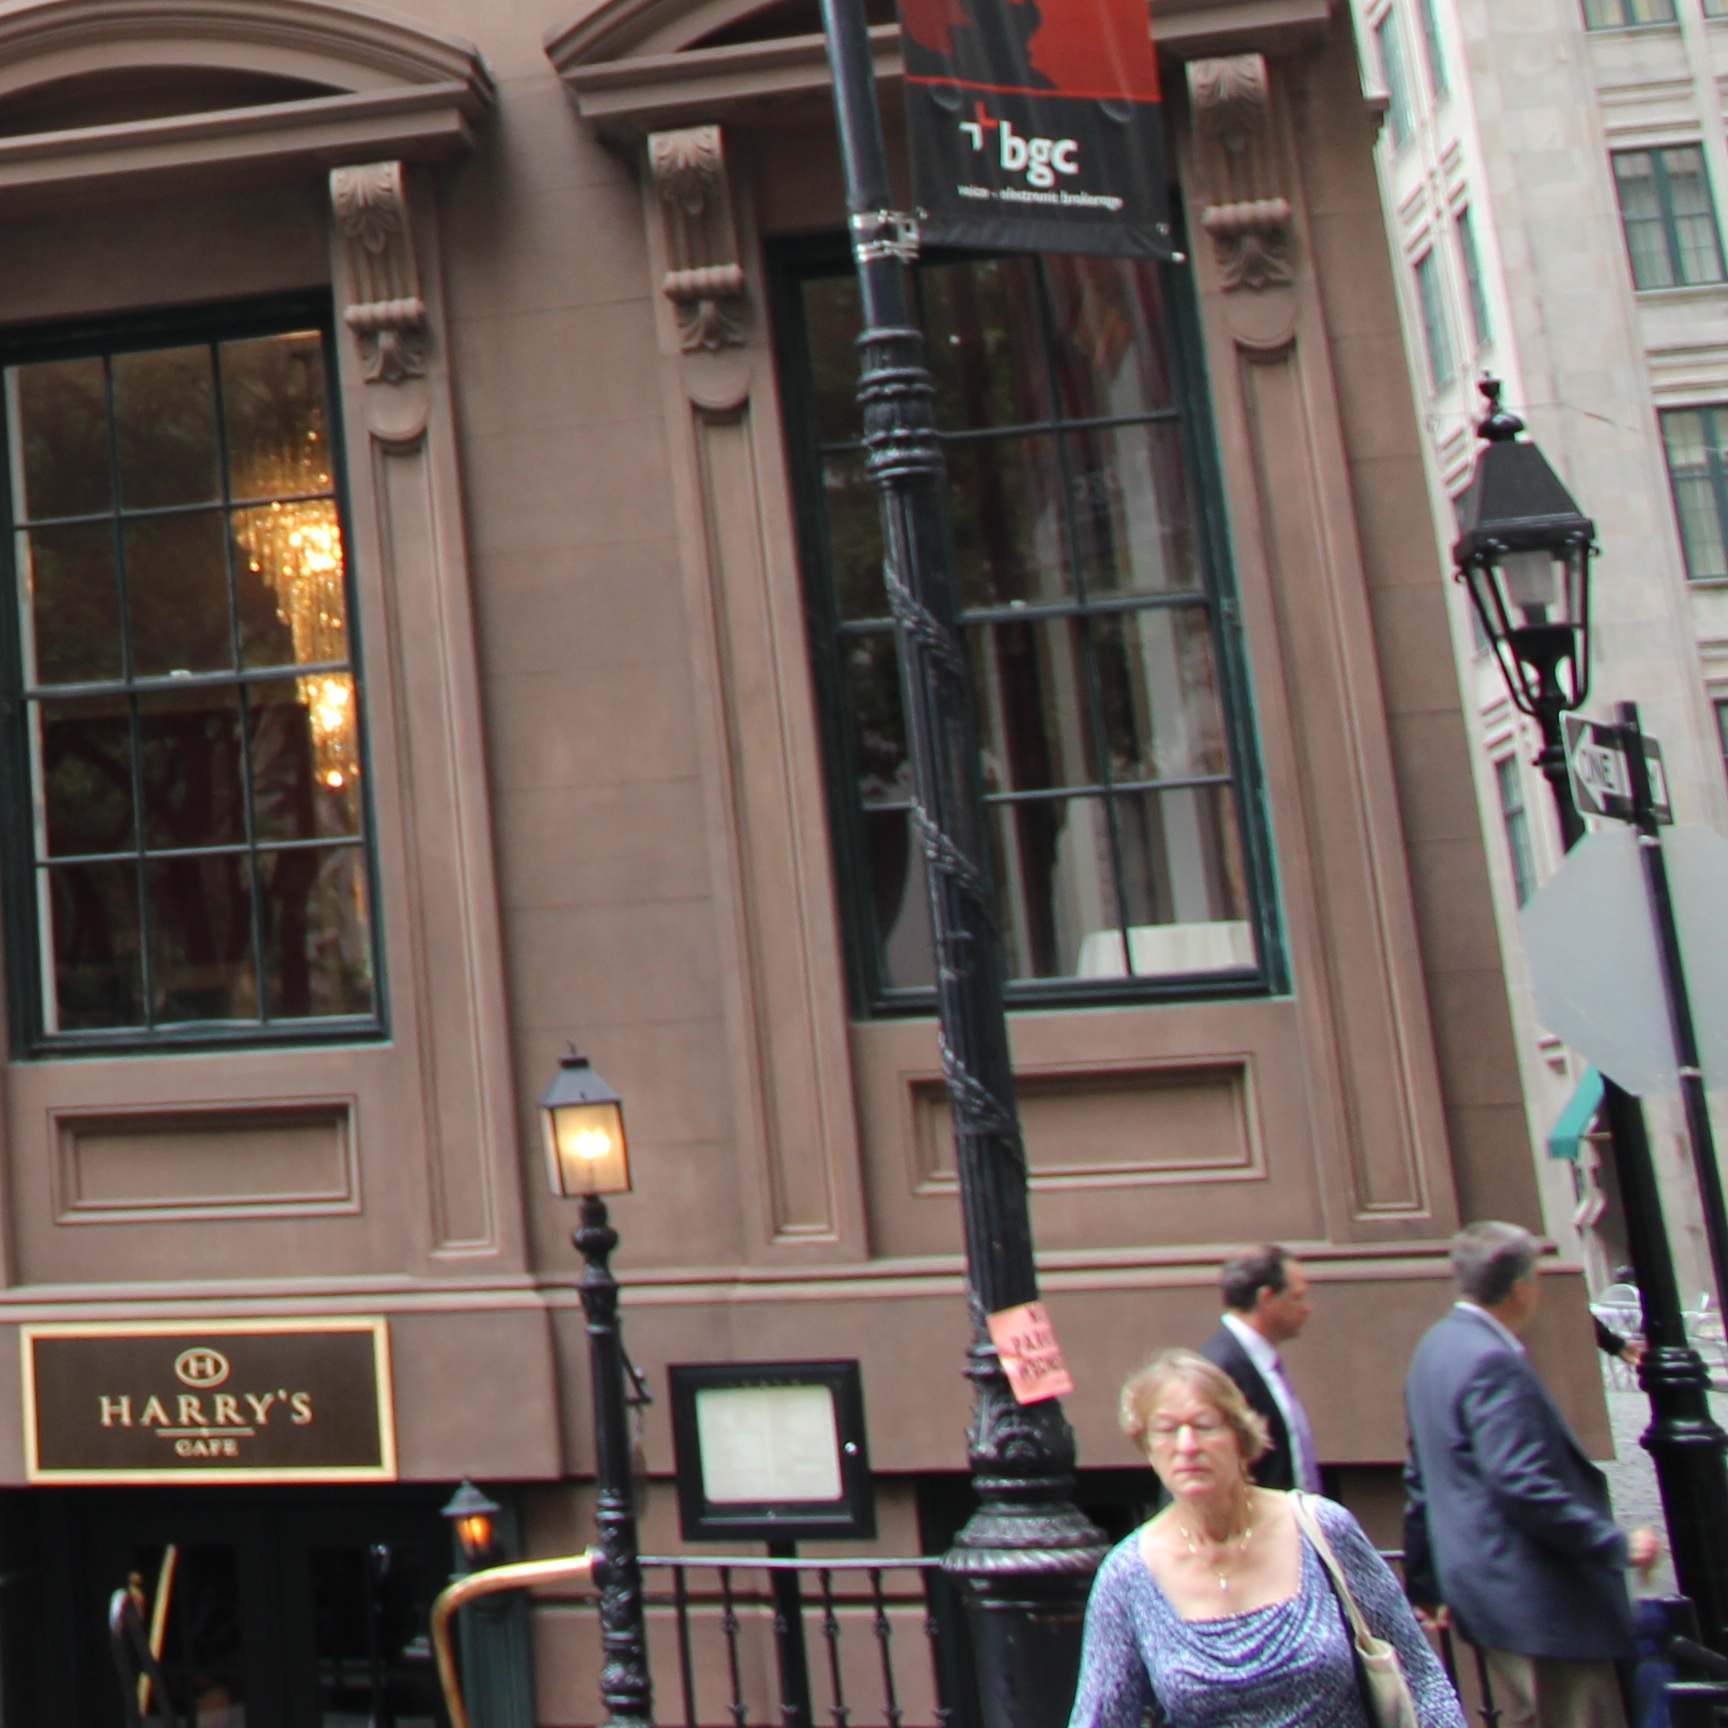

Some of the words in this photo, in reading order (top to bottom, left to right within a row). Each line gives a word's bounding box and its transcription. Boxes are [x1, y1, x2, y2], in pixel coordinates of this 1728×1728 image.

[999, 120, 1080, 188] bgc
[188, 1357, 215, 1377] H
[99, 1388, 314, 1427] HARRY'S
[175, 1439, 240, 1457] CAFE
